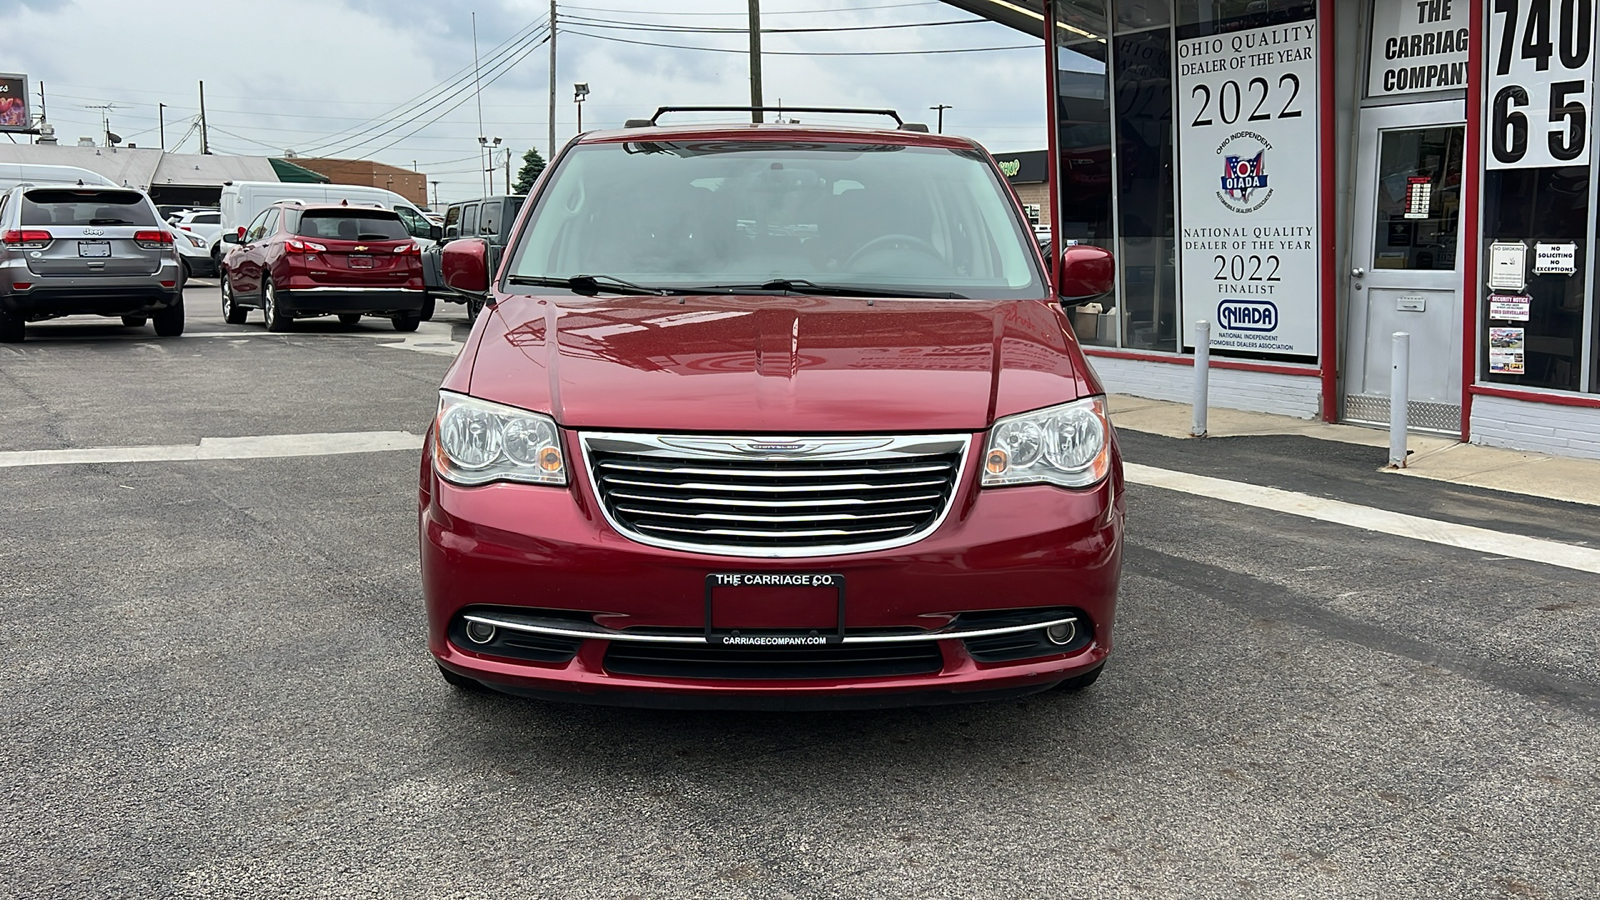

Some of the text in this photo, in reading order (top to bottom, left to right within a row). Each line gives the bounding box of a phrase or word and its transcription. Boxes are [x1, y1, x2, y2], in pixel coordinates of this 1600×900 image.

[1416, 1, 1451, 24] THE
[1179, 24, 1315, 58] OHIO QUALITY
[1384, 28, 1469, 60] CARRIAG
[1494, 0, 1591, 76] 740
[1181, 58, 1227, 76] DEALER
[1230, 56, 1246, 70] OF
[1249, 52, 1274, 67] THE
[1277, 47, 1312, 63] YEAR
[1191, 73, 1302, 127] 2022
[1216, 131, 1273, 155] OHIO INDEPENDENT
[1226, 176, 1260, 189] OIADA
[1183, 226, 1313, 239] NATIONAL QUALITY
[1185, 241, 1312, 250] DEALER OF THE YEAR
[1213, 254, 1281, 282] 2022
[1218, 284, 1275, 294] FINALIST
[1222, 306, 1272, 327] NIADA
[716, 574, 835, 586] THE CARRIAGE CO.
[722, 636, 826, 645] CARRIAGECOMPANY.COM
